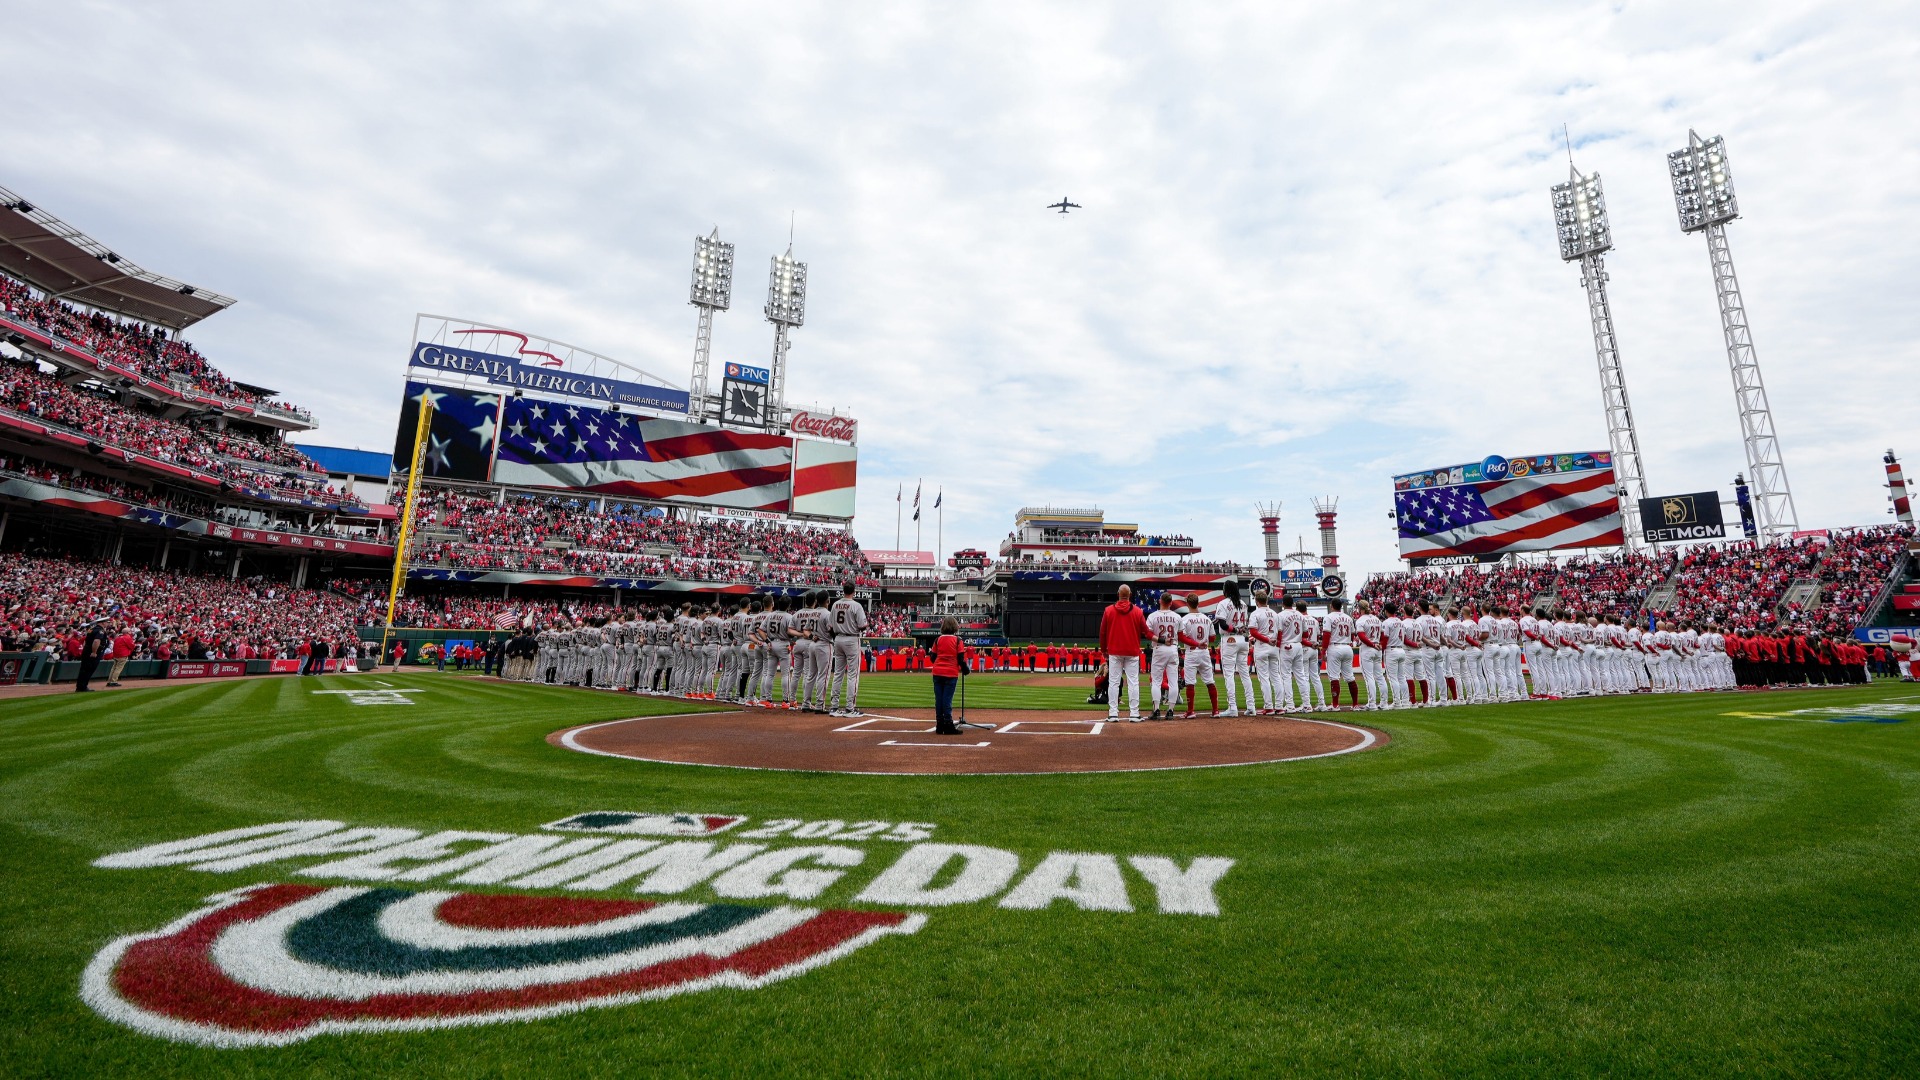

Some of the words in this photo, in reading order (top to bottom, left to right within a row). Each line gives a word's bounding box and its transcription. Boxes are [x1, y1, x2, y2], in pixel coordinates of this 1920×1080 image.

[741, 366, 769, 381] PNC
[619, 394, 660, 406] INSURANCE
[661, 401, 685, 410] GROUP
[791, 411, 857, 440] Coca-Cola
[1486, 462, 1506, 474] P&G
[1510, 461, 1528, 474] Tide
[727, 509, 753, 517] TOYOTA
[754, 511, 781, 520] TUNDRA
[1646, 524, 1722, 541] BETMGM
[1431, 555, 1475, 566] GRAVITY
[1296, 568, 1316, 578] PNC
[861, 592, 872, 600] PM
[837, 611, 846, 625] 6
[1232, 611, 1245, 625] 44
[769, 622, 781, 634] 51
[1158, 624, 1174, 639] 29
[1196, 625, 1205, 640] 9
[1268, 619, 1274, 633] 2
[1293, 621, 1301, 635] 3
[1338, 624, 1350, 638] 33
[1370, 625, 1380, 639] 27
[1428, 626, 1438, 638] 15
[658, 632, 668, 641] 29
[1398, 628, 1403, 641] 4
[1412, 630, 1421, 643] 12
[737, 818, 937, 842] 2025
[91, 819, 866, 899] OPENING
[852, 843, 1237, 916] DAY
